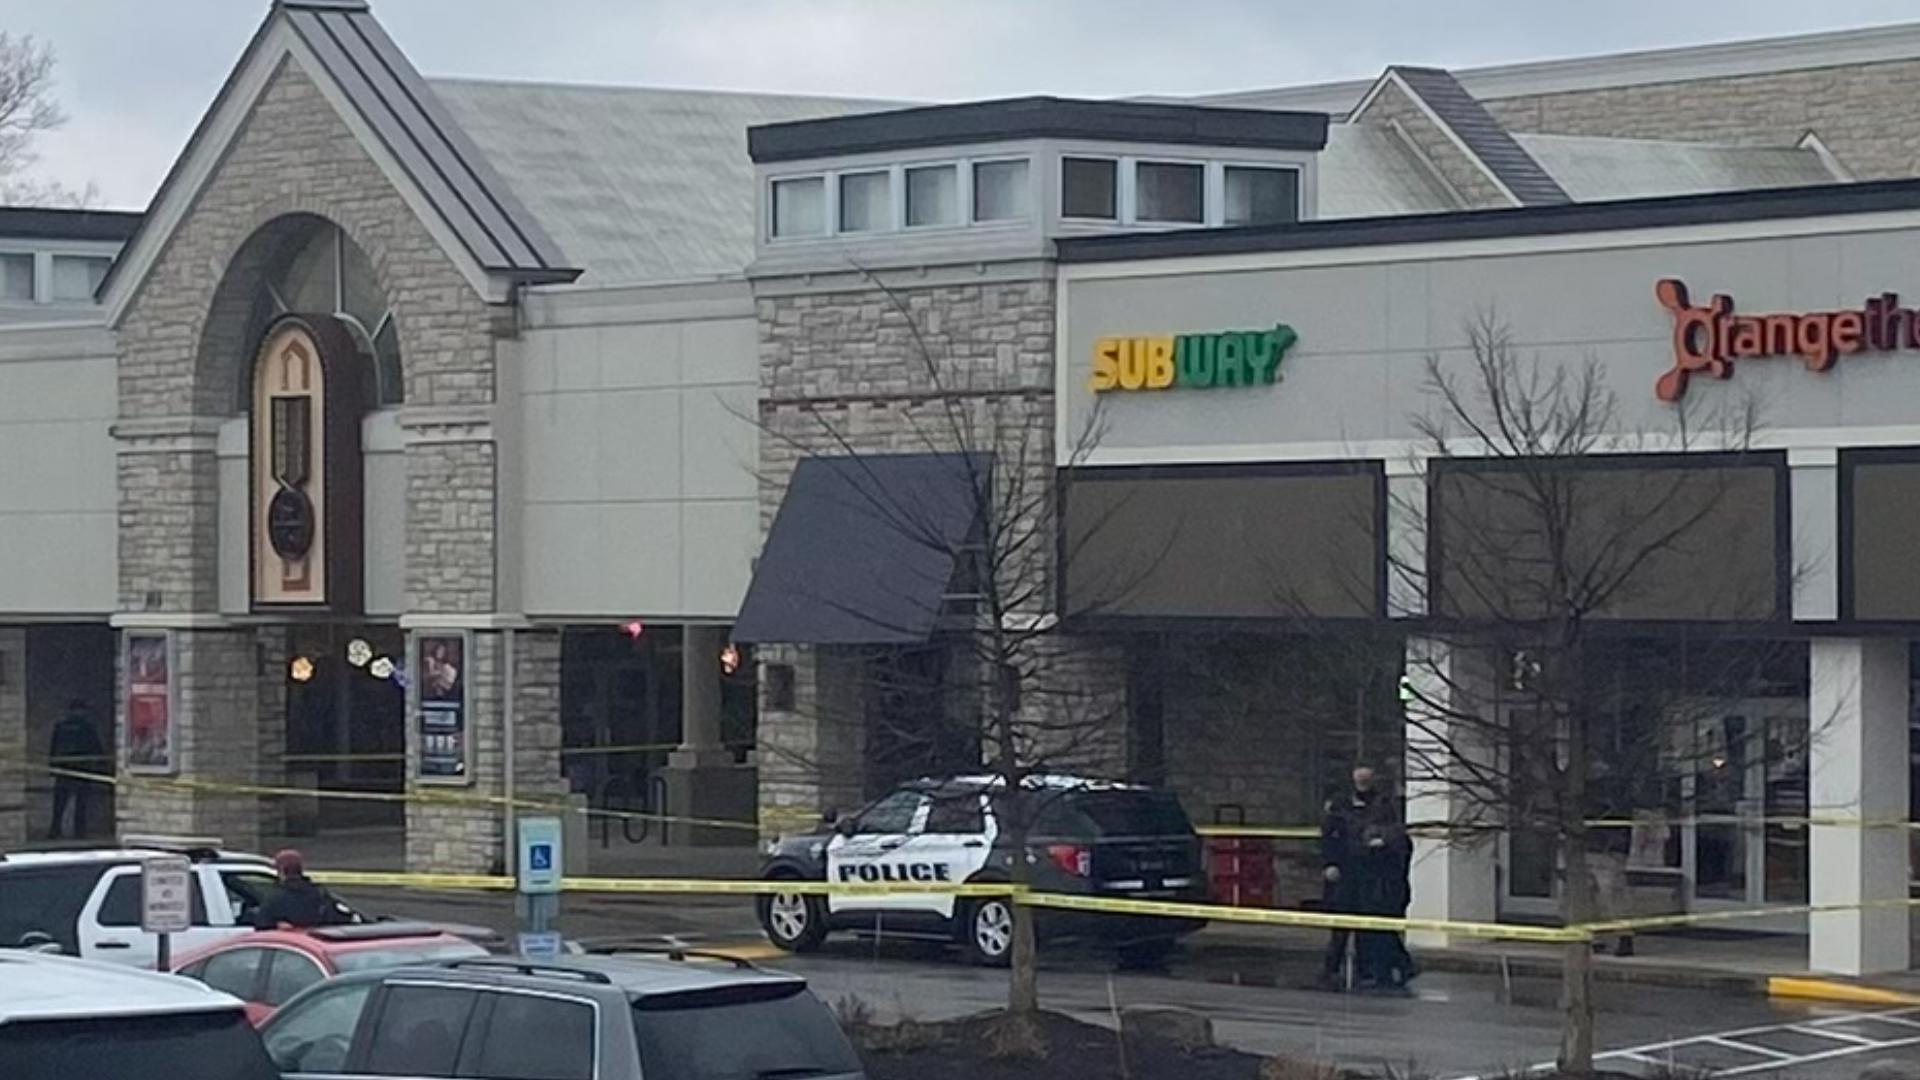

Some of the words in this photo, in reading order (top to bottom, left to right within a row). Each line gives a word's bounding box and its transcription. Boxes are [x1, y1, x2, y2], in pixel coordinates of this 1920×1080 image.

[1092, 325, 1297, 392] SUBWAY
[1656, 280, 1920, 401] Orangeth
[838, 863, 951, 882] POLICE
